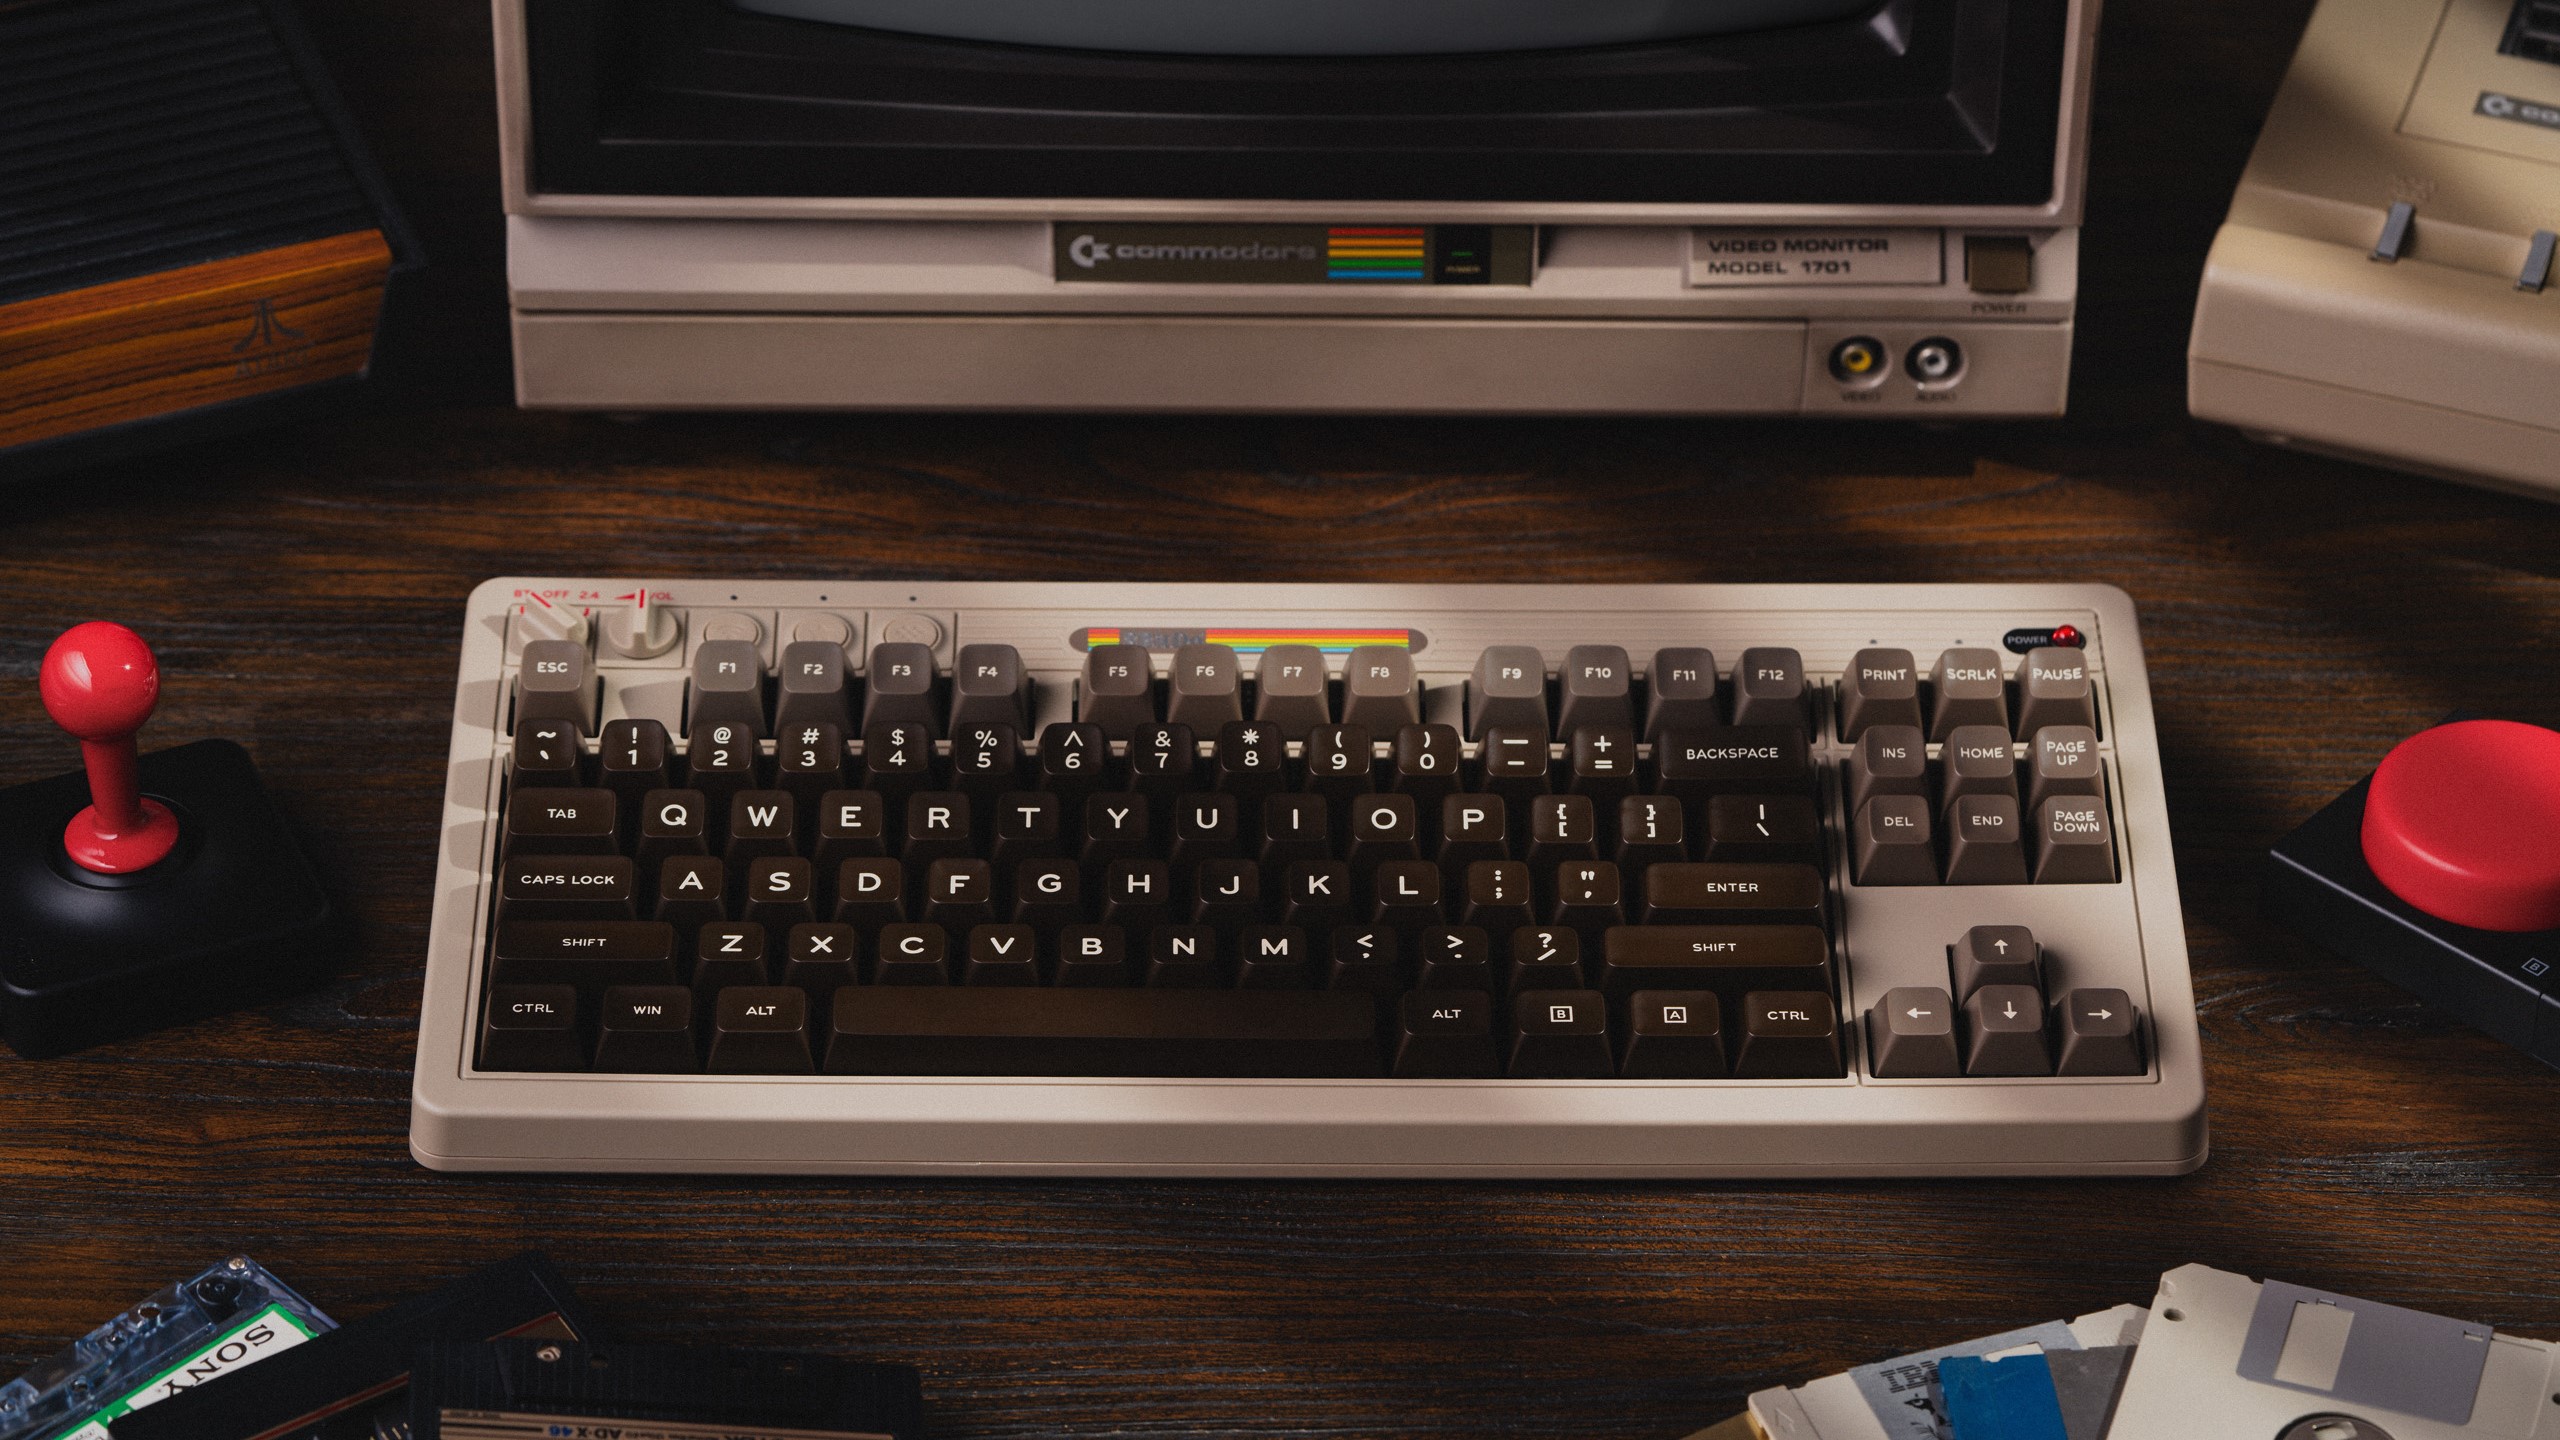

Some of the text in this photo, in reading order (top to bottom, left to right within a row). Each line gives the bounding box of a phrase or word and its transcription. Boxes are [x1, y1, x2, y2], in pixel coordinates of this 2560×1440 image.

[1115, 241, 1318, 260] commodore
[1708, 237, 1890, 253] VIDEO MONITOR
[1708, 260, 1851, 275] MODEL 1701
[542, 590, 570, 598] OFF
[2007, 635, 2048, 645] POWER
[537, 661, 568, 673] ESC
[718, 662, 736, 674] F1
[803, 663, 824, 675] F2
[892, 664, 912, 676] F3
[978, 666, 998, 678] F4
[1108, 665, 1128, 677] F5
[1196, 665, 1215, 677] F6
[1283, 666, 1303, 678] F7
[1370, 666, 1390, 678] F8
[1502, 667, 1522, 680] F9
[1585, 666, 1612, 679] F10
[1673, 669, 1696, 681] F11
[1758, 669, 1784, 681] F12
[1863, 668, 1907, 681] PRINT
[1946, 667, 1997, 681] SCRLK
[2031, 667, 2083, 681] PAUSE
[536, 731, 557, 739] ~
[631, 726, 638, 744] !
[713, 726, 732, 744] @
[801, 727, 820, 745] #
[891, 728, 905, 746] $
[974, 730, 998, 748] %
[1155, 730, 1171, 747] &
[1335, 731, 1343, 749] (
[1423, 731, 1431, 749] )
[1593, 735, 1612, 753] +
[2046, 740, 2087, 753] PAGE
[627, 749, 638, 766] 1
[712, 749, 729, 766] 2
[800, 750, 816, 767] 3
[888, 750, 907, 766] 4
[976, 751, 992, 769] 5
[1065, 752, 1081, 769] 6
[1154, 752, 1169, 769] 7
[1244, 750, 1259, 767] 8
[1686, 747, 1779, 760] BACKSPACE
[1882, 747, 1906, 759] INS
[1960, 746, 2004, 759] HOME
[2056, 754, 2078, 766] UP
[1331, 753, 1347, 770] 9
[1594, 759, 1613, 769] =
[547, 808, 577, 819] TAB
[660, 803, 687, 826] Q
[747, 805, 778, 827] W
[840, 805, 862, 827] E
[927, 807, 951, 829] R
[1017, 807, 1041, 828] T
[1106, 807, 1129, 829] Y
[1196, 808, 1218, 829] U
[1292, 808, 1299, 830] I
[1371, 808, 1397, 830] O
[1462, 808, 1485, 830] P
[1556, 803, 1567, 820] {
[1646, 804, 1657, 821] }
[2055, 810, 2096, 822] PAGE
[1884, 816, 1914, 827] DEL
[1972, 815, 2004, 826] END
[2053, 819, 2100, 833] DOWN
[1558, 821, 1568, 837] [
[1646, 822, 1656, 838] ]
[520, 875, 615, 885] CAPS LOCK
[678, 870, 704, 890] A
[768, 871, 791, 892] S
[858, 872, 882, 892] D
[949, 874, 971, 895] F
[1037, 873, 1062, 893] G
[1127, 874, 1151, 894] H
[1219, 875, 1240, 895] J
[1308, 875, 1331, 895] K
[1398, 875, 1419, 895] L
[1706, 882, 1759, 893] ENTER
[562, 938, 607, 947] SHIFT
[720, 934, 744, 952] Z
[810, 935, 834, 953] X
[899, 936, 925, 955] C
[990, 937, 1015, 955] V
[1081, 937, 1103, 955] B
[1172, 937, 1195, 955] N
[1261, 938, 1288, 956] M
[1356, 934, 1374, 948] <
[1446, 934, 1464, 949] >
[1538, 932, 1553, 949] ?
[1692, 943, 1737, 952] SHIFT
[1537, 947, 1557, 961] /
[512, 1003, 555, 1013] CTRL
[633, 1005, 662, 1015] WIN
[745, 1006, 777, 1016] ALT
[1432, 1009, 1462, 1019] ALT
[1556, 1009, 1566, 1019] B
[1669, 1010, 1681, 1020] A
[1767, 1010, 1810, 1021] CTRL
[162, 1323, 276, 1398] SONY
